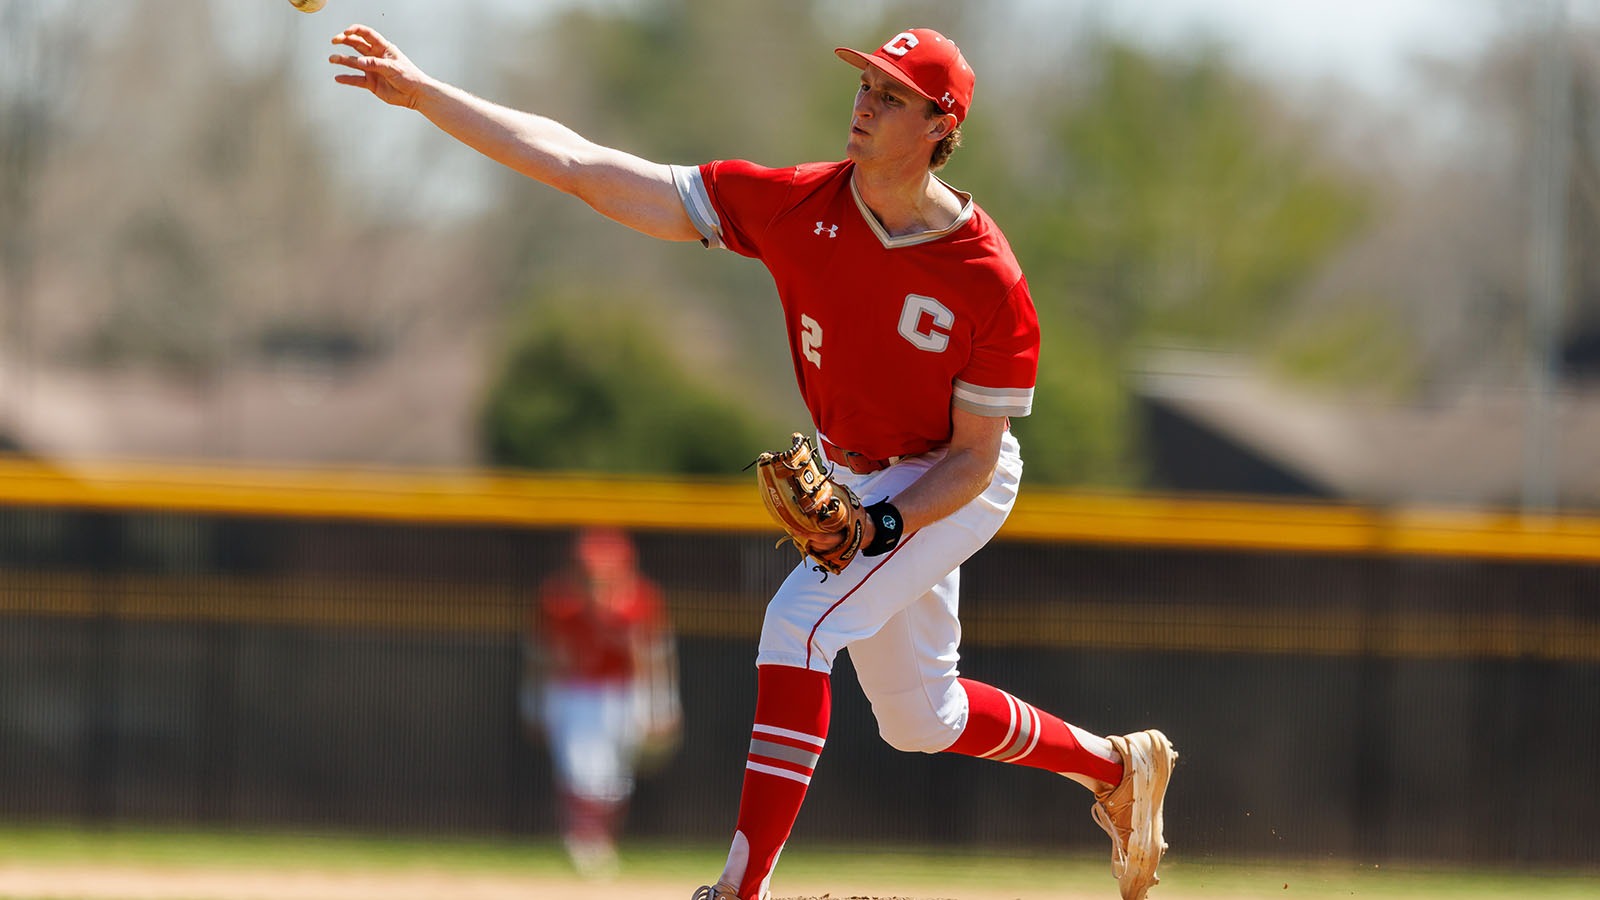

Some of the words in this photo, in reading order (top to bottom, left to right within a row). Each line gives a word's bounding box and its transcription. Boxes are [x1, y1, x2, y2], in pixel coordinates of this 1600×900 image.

[882, 32, 920, 57] C
[801, 313, 823, 370] 2
[897, 293, 955, 353] C
